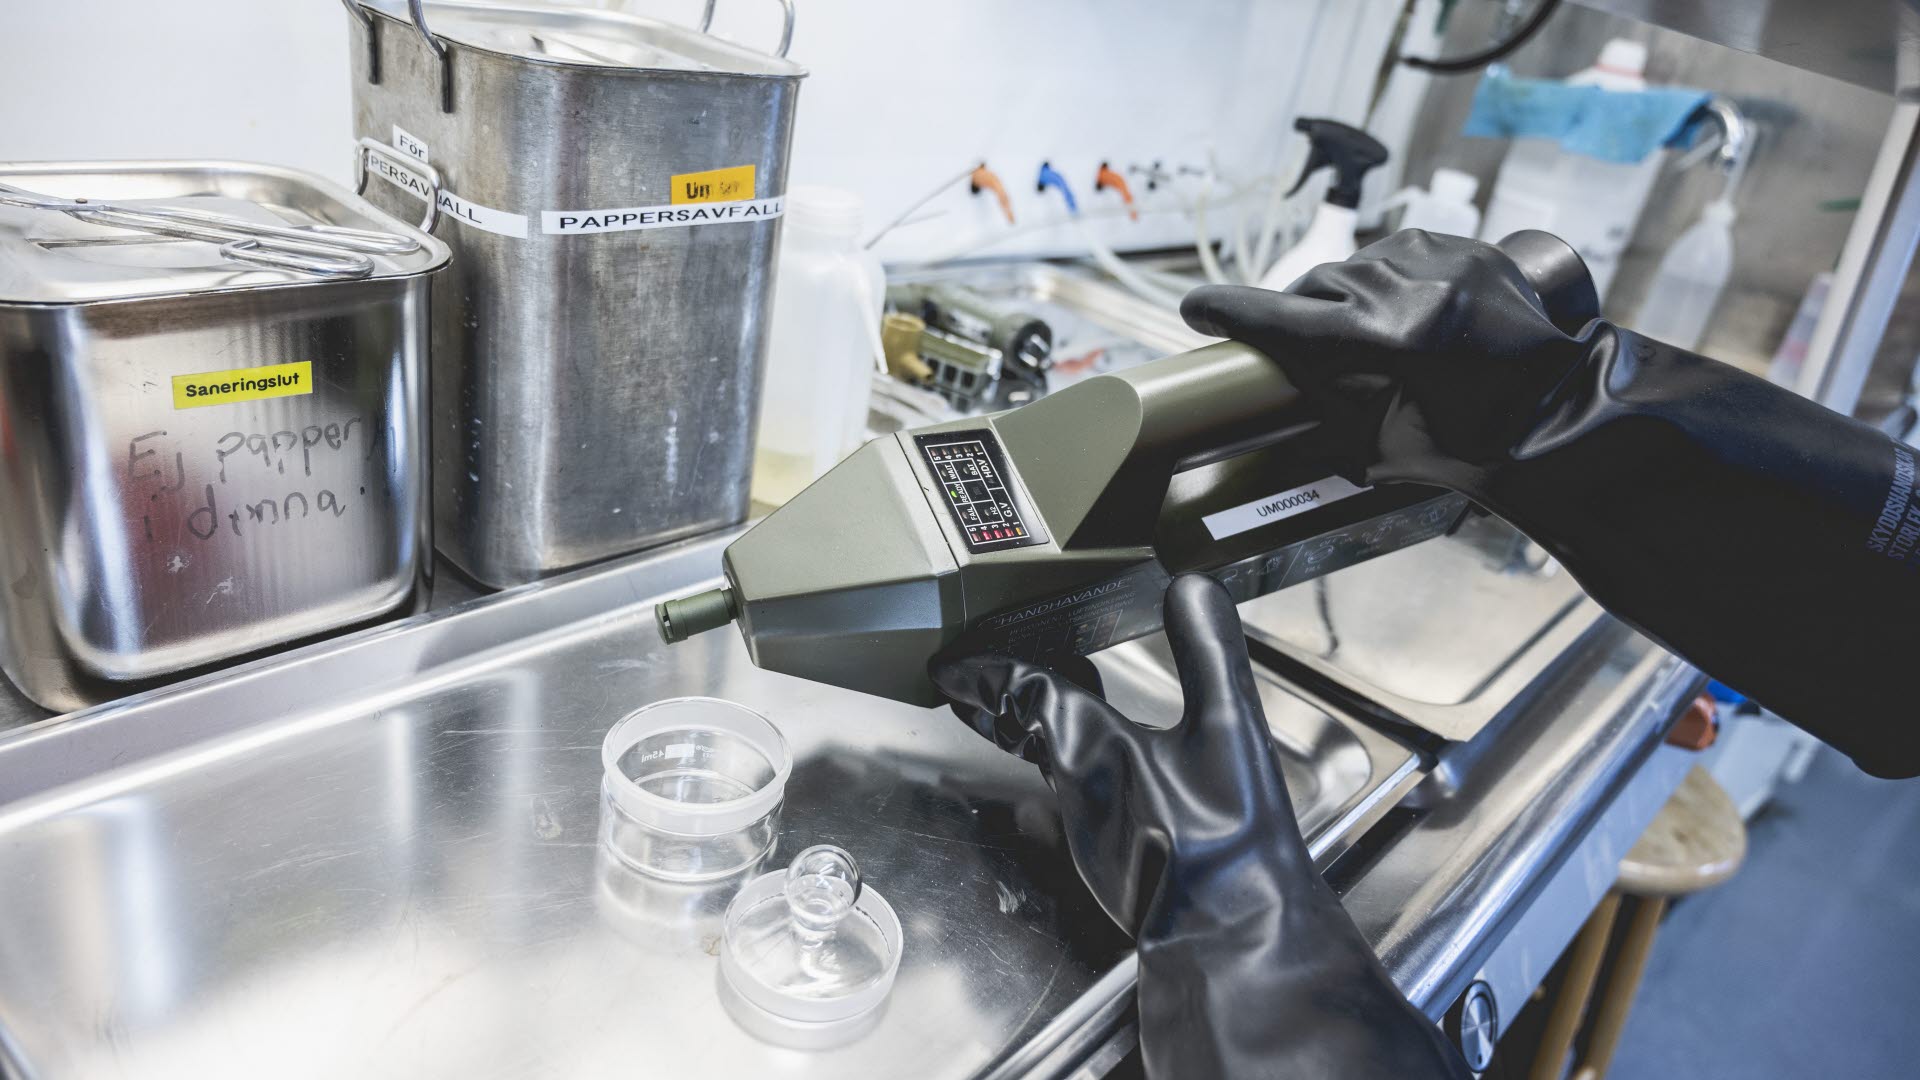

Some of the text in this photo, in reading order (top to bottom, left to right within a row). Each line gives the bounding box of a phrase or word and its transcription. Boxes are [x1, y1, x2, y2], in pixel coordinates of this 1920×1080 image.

[400, 135, 425, 158] För
[559, 203, 784, 230] PAPPERSAVFALL
[185, 371, 300, 398] Saneringslut
[215, 416, 361, 484] papper
[945, 464, 957, 480] WAIT
[954, 483, 969, 503] READY
[1255, 489, 1320, 517] UM000034
[966, 506, 978, 521] FAIL
